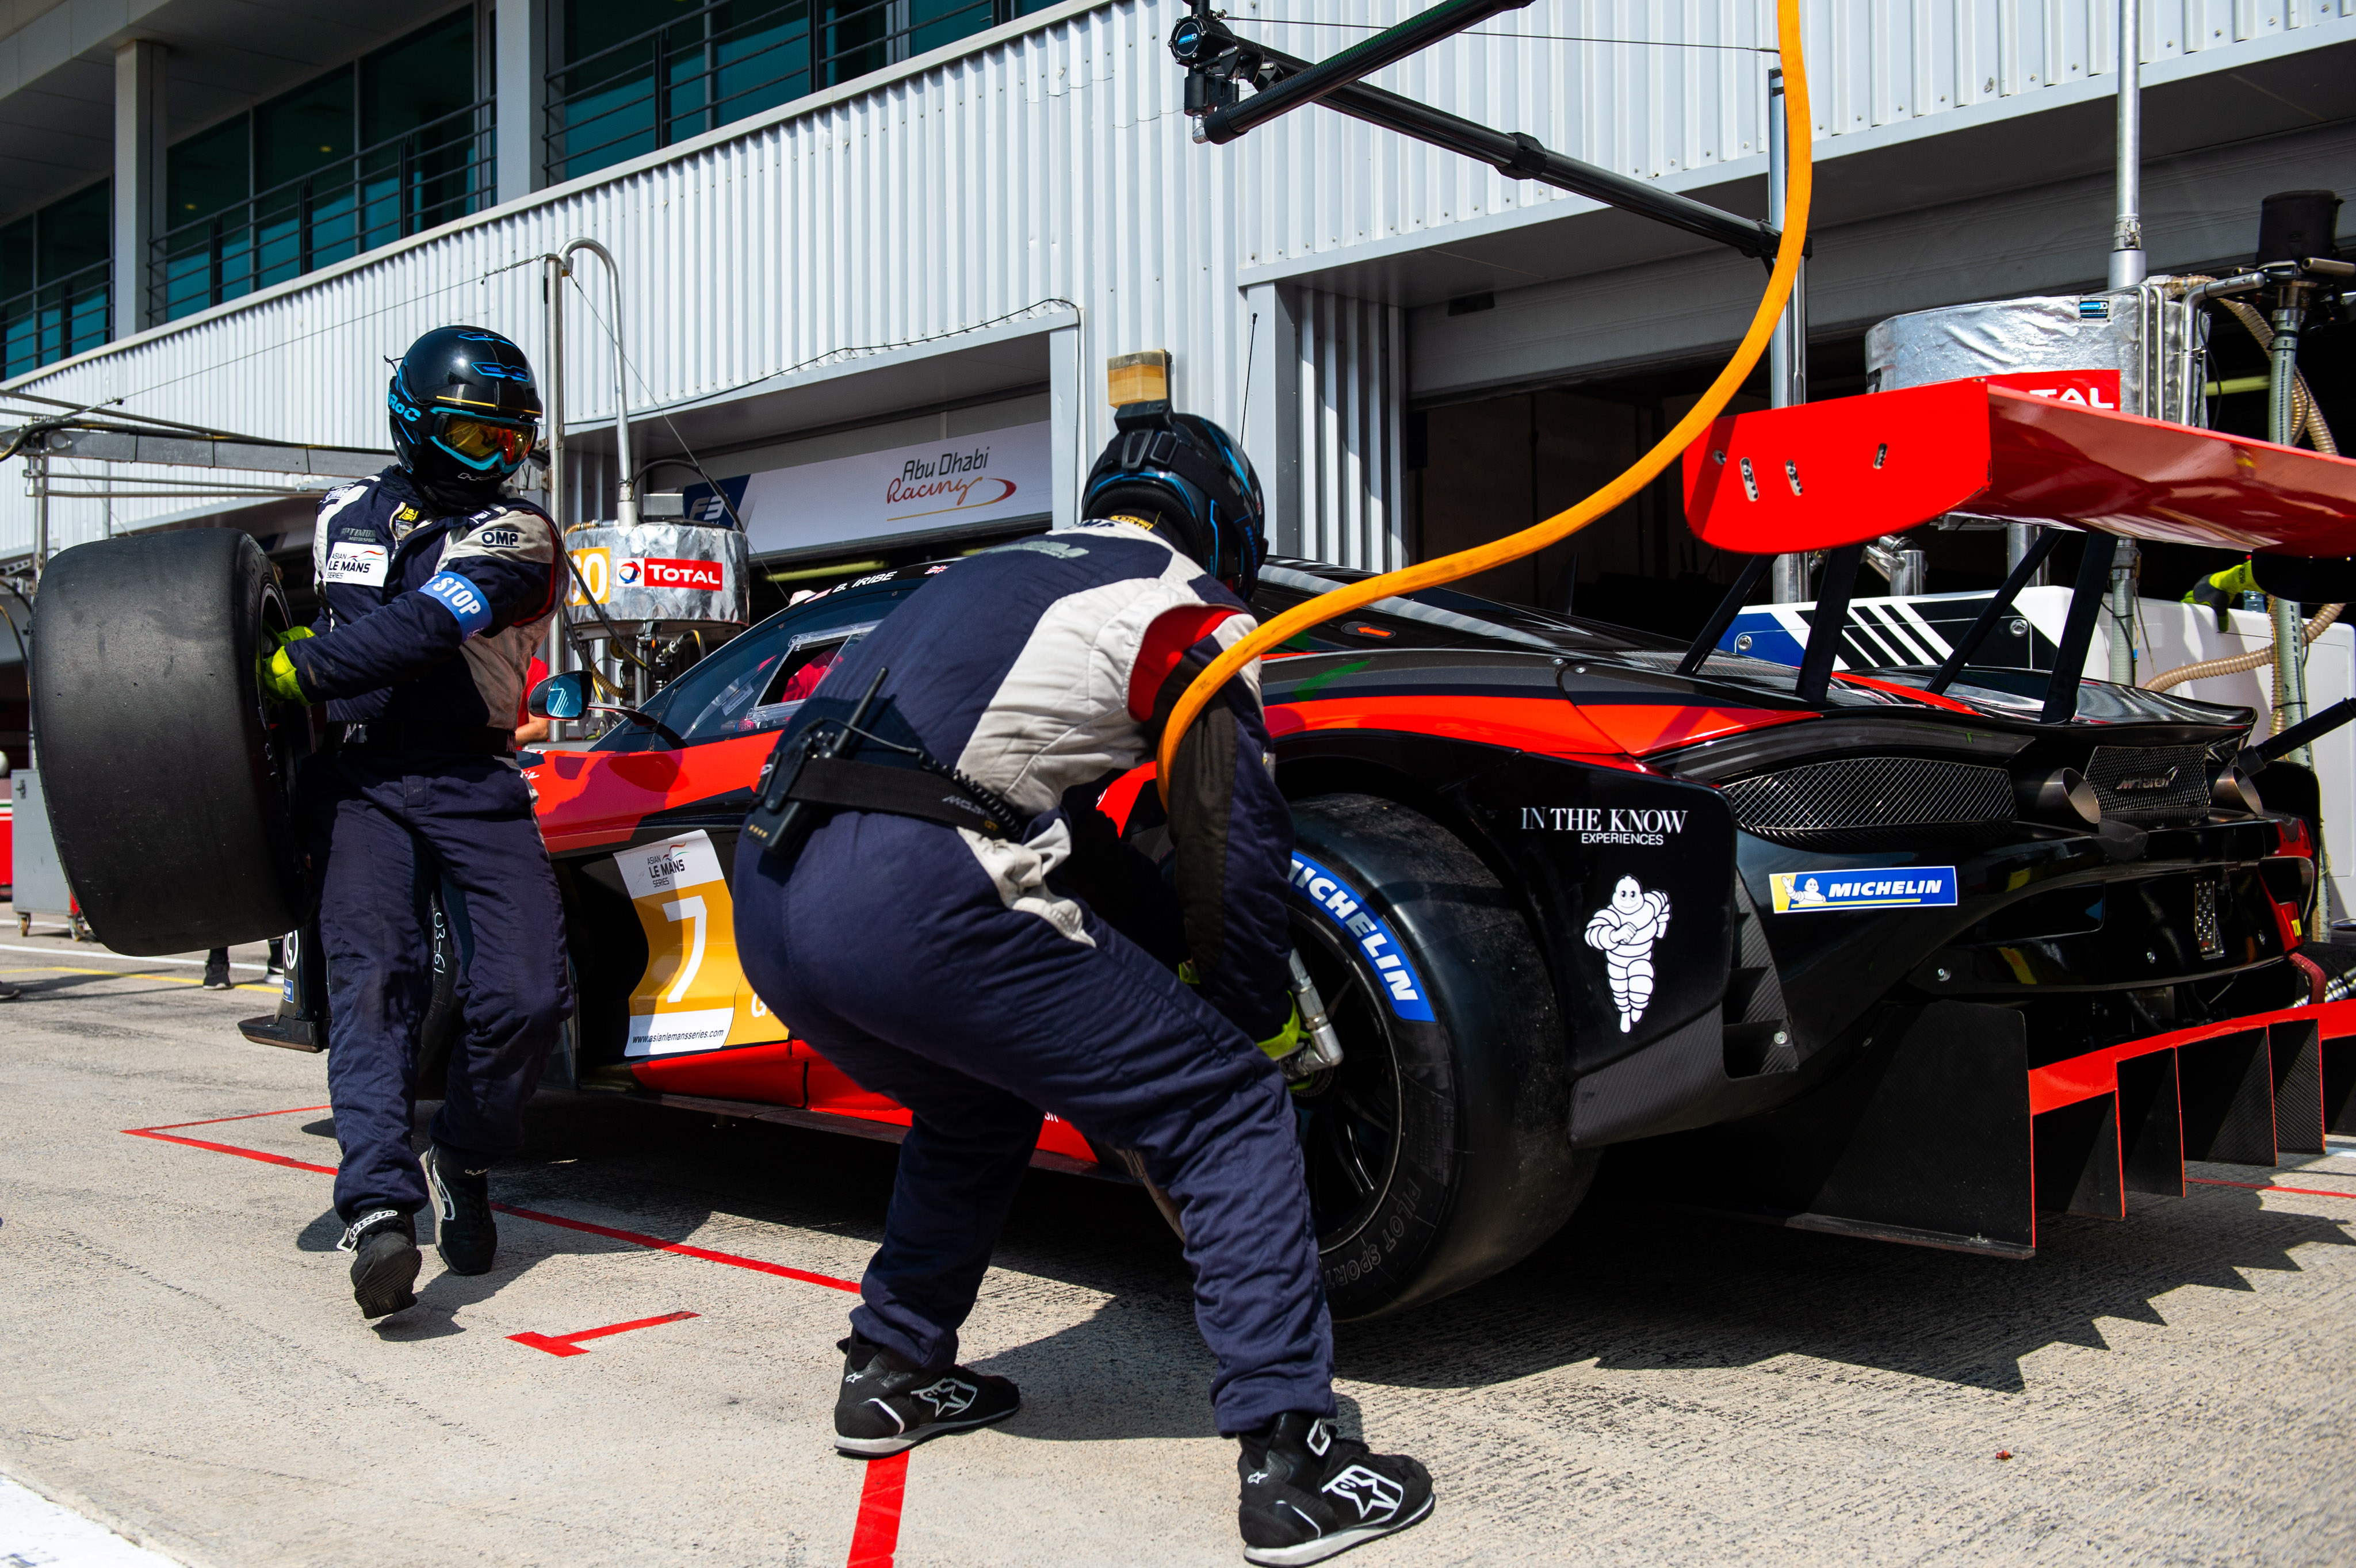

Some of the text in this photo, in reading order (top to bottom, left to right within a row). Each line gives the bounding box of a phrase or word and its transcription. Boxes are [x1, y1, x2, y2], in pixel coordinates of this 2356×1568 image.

[2029, 387, 2114, 409] TAL
[902, 446, 990, 482] Abu Dhabi
[886, 476, 984, 506] Racing
[481, 531, 518, 546] OMP
[328, 560, 371, 573] LE MANS
[648, 564, 720, 585] TOTAL
[832, 571, 898, 593] B. IRIBE
[433, 577, 481, 615] STOP
[1520, 806, 1689, 833] IN THE KNOW
[1581, 833, 1664, 846] EXPERIENCES
[647, 855, 661, 865] ASIAN
[649, 859, 685, 878] LE MANS
[652, 877, 670, 888] SERIES
[1828, 879, 1942, 898] MICHELIN
[661, 894, 707, 1003] 7
[632, 1029, 724, 1044] www.asianlemansseries.com
[1382, 1179, 1422, 1253] PILOT
